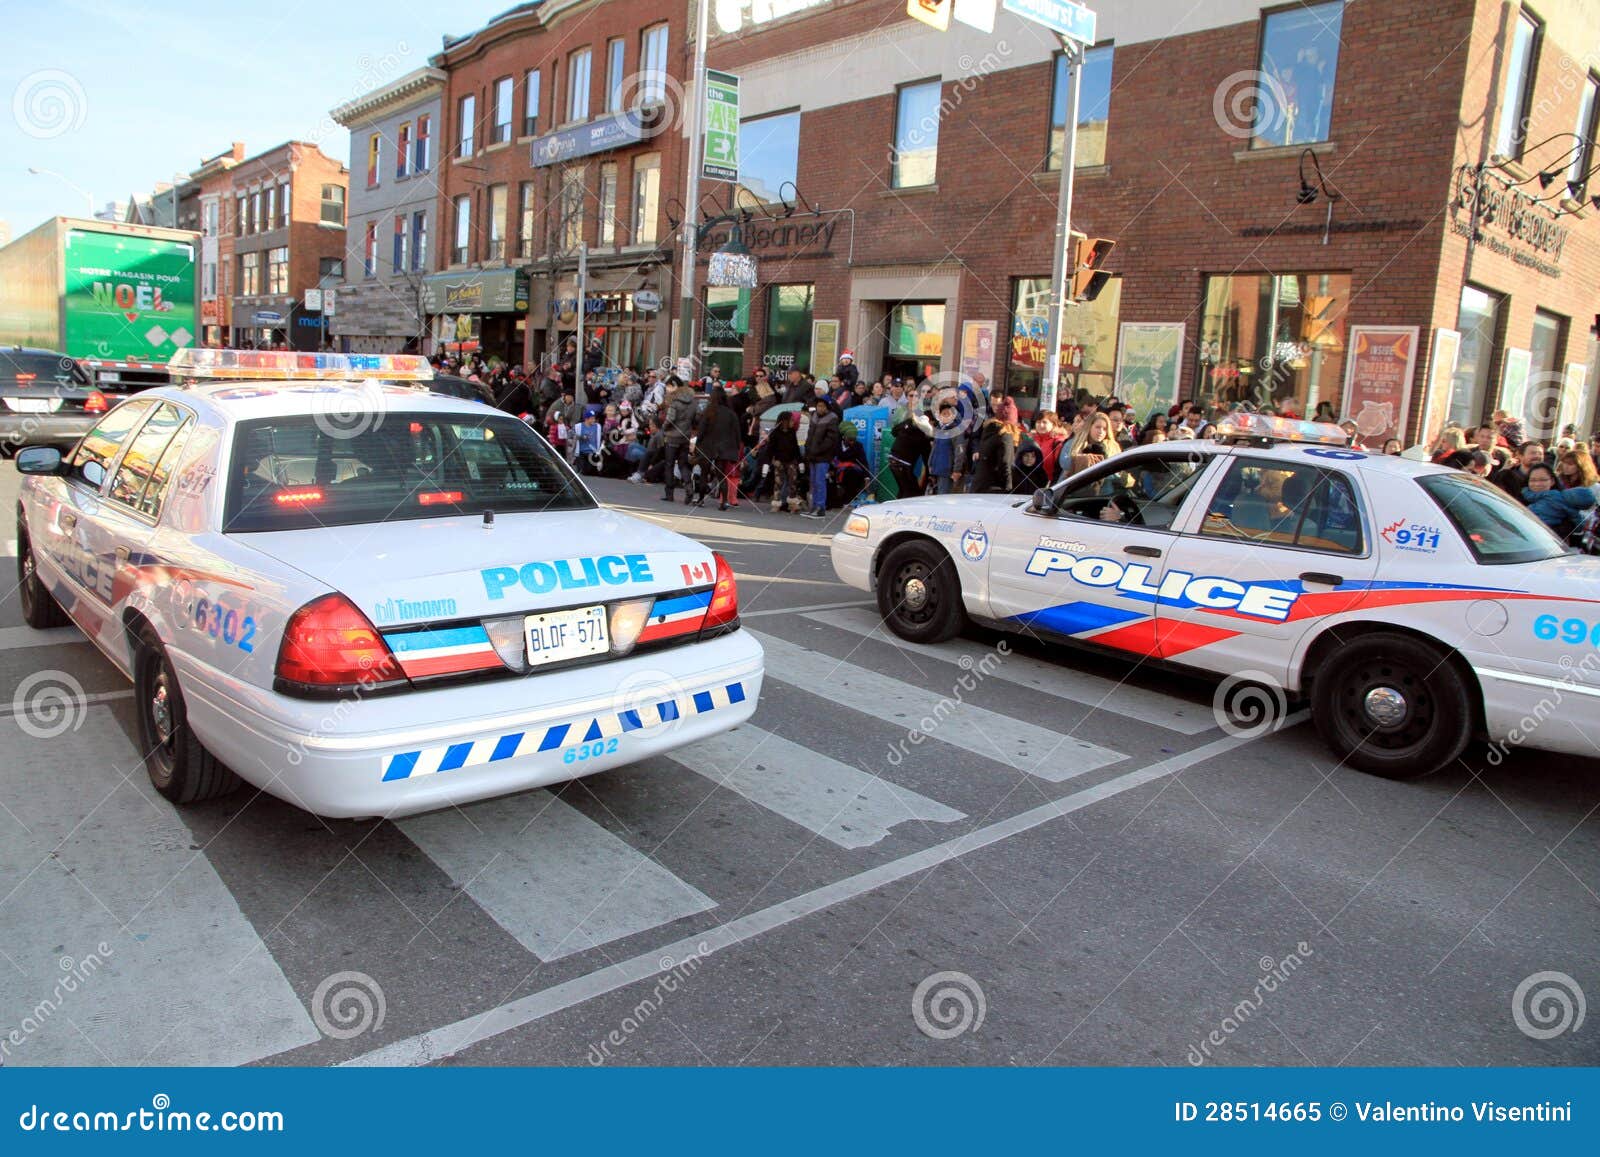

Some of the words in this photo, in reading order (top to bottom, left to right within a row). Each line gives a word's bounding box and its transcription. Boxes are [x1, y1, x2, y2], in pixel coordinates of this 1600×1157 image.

[1018, 0, 1073, 28] hurst
[709, 88, 724, 100] the
[744, 220, 836, 252] Beanery
[113, 270, 154, 280] MAGASIN
[156, 275, 180, 283] POUR
[93, 281, 174, 312] NOËL
[763, 355, 794, 366] COFFEE
[1395, 530, 1440, 548] 9-1-1
[1411, 525, 1440, 534] CALL
[1039, 535, 1086, 552] Toronto
[480, 554, 653, 600] POLICE
[1025, 548, 1299, 622] POLICE
[195, 597, 256, 653] 6302
[531, 627, 567, 652] BLDF
[578, 619, 604, 644] 571
[563, 738, 619, 764] 6302
